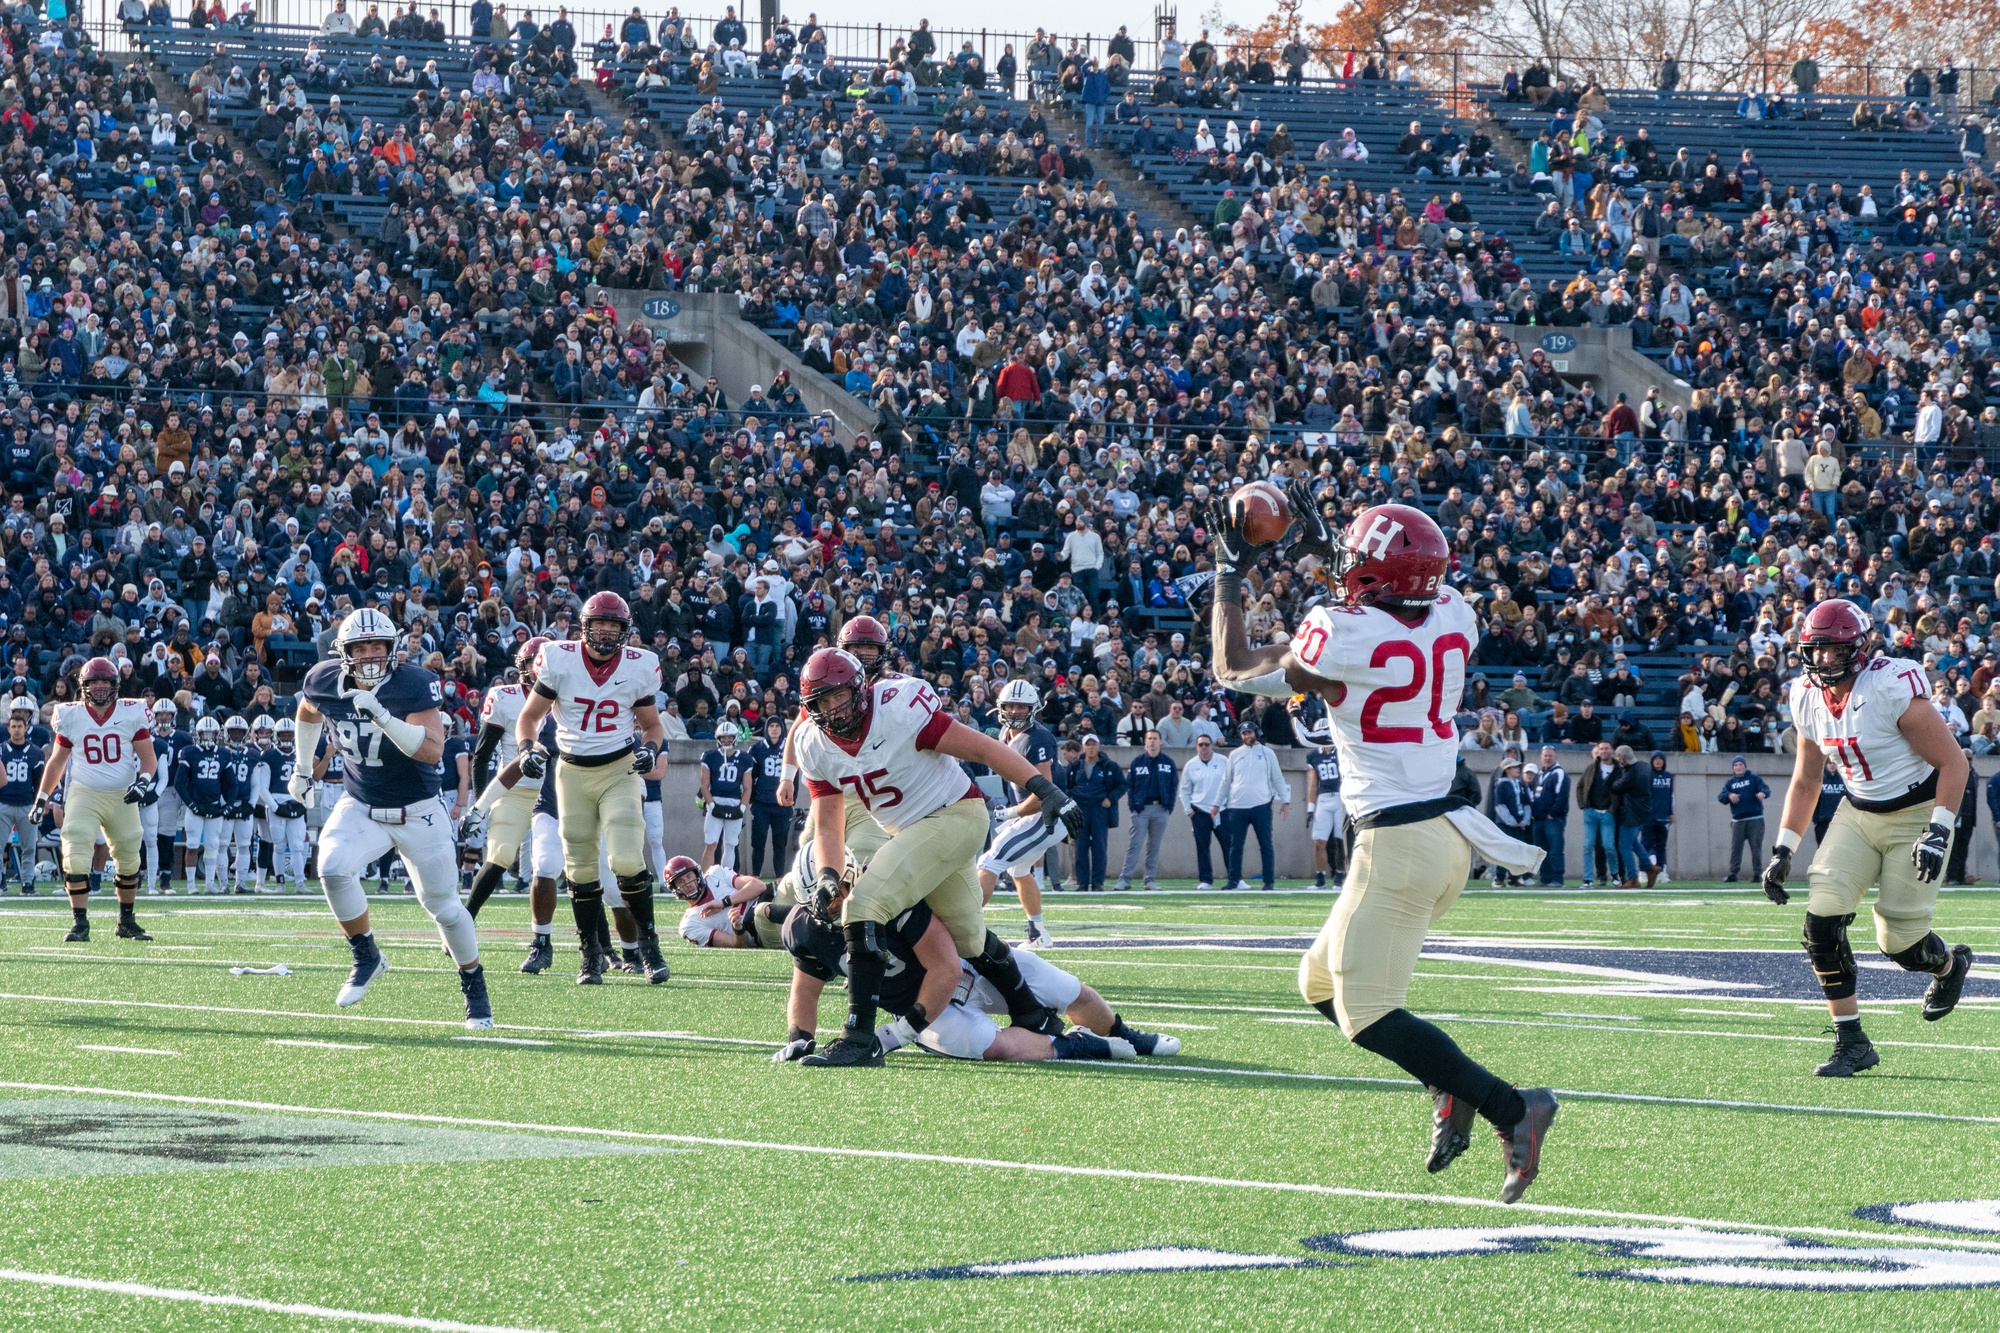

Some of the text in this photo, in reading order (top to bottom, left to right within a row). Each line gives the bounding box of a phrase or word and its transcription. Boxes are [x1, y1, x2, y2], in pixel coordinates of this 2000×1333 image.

[238, 15, 248, 25] Y
[652, 300, 670, 315] 18
[671, 304, 678, 312] C
[1550, 335, 1566, 350] 19
[12, 448, 30, 456] YALE
[1820, 463, 1829, 473] Y
[1358, 514, 1404, 561] H
[1425, 573, 1445, 591] 20
[808, 615, 827, 623] YALE
[1294, 620, 1328, 666] 20
[429, 681, 444, 702] 97
[1360, 632, 1470, 744] 20
[1897, 669, 1926, 698] 71
[909, 685, 942, 715] 75
[574, 696, 619, 733] 72
[84, 733, 121, 764] 60
[336, 720, 384, 767] 97
[1038, 747, 1046, 761] 2
[1823, 737, 1873, 781] 71
[6, 761, 29, 782] 98
[197, 760, 220, 779] 32
[280, 764, 293, 781] 3
[718, 765, 738, 782] 10
[764, 757, 783, 777] 82
[1318, 763, 1339, 781] 80
[839, 767, 904, 813] 75
[1731, 780, 1750, 789] YALE
[1821, 783, 1844, 791] YALE
[421, 814, 433, 826] Y
